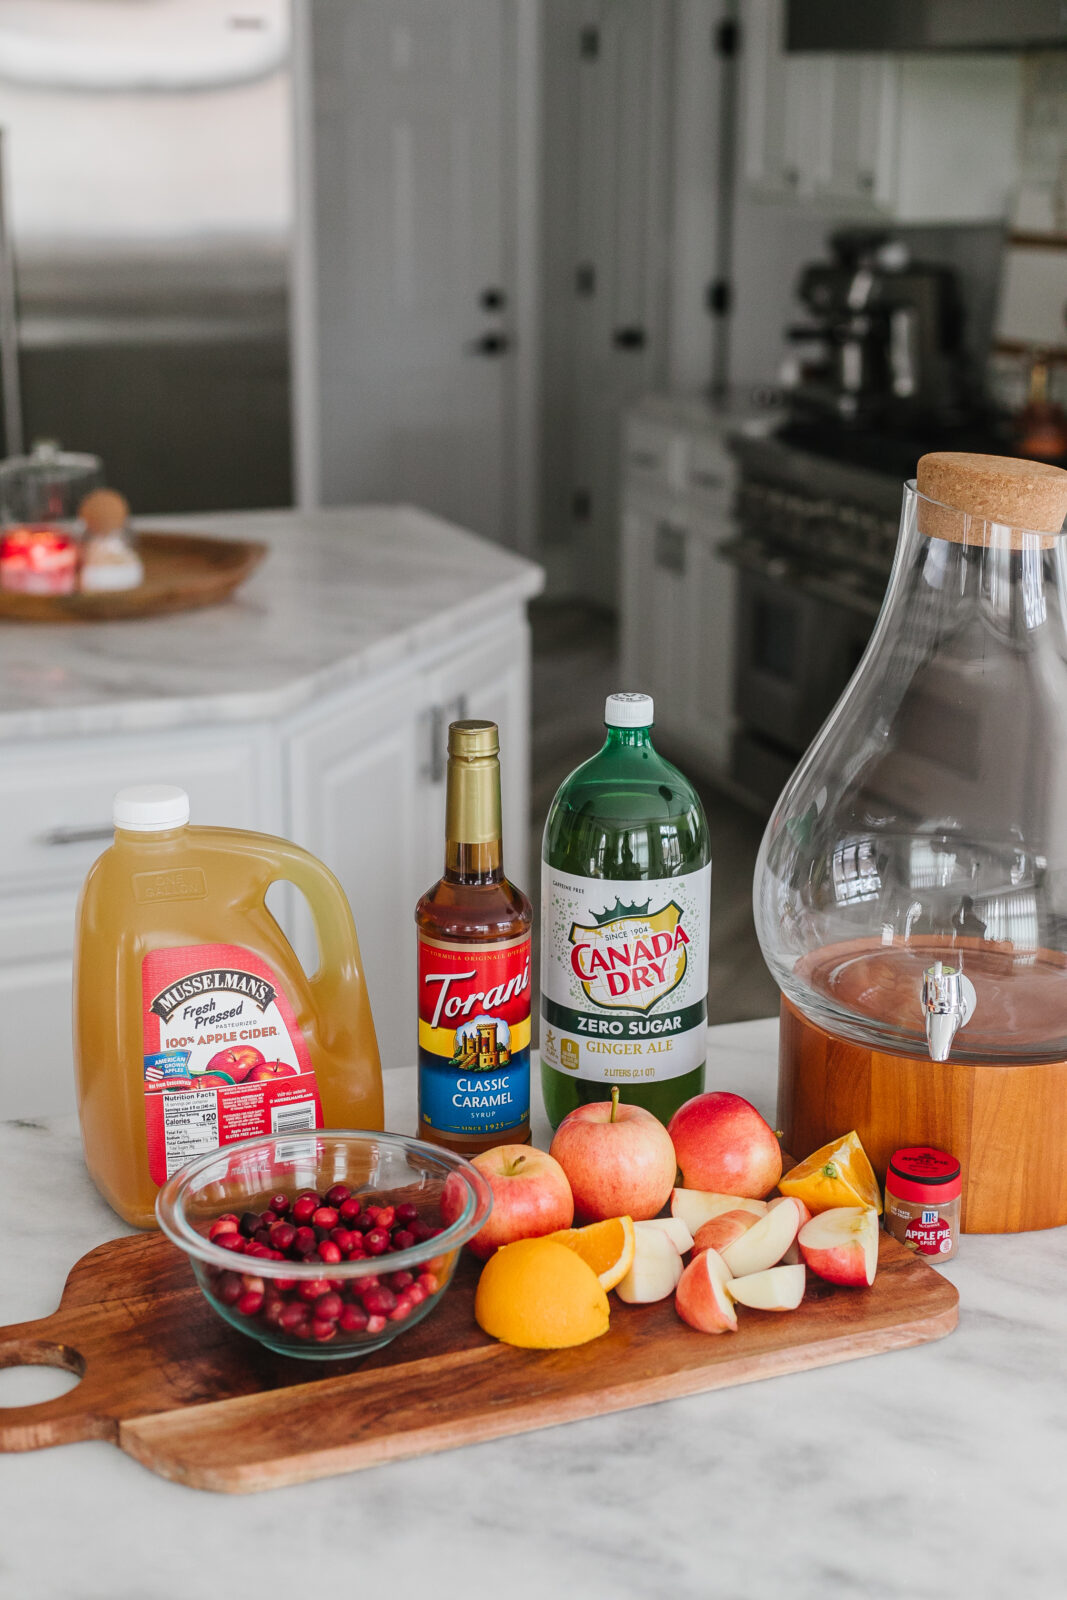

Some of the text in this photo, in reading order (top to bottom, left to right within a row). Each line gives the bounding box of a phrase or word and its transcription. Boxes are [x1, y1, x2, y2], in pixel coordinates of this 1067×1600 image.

[605, 926, 648, 941] SINCE 1904
[430, 951, 461, 960] FORMULA
[571, 924, 690, 981] CANADA
[606, 957, 667, 996] DRY
[158, 973, 269, 1012] MUSSELMAN'S
[425, 955, 529, 1028] Torani
[183, 998, 216, 1020] Fresh
[194, 1001, 244, 1029] Pressed
[215, 1020, 258, 1029] PASTEURIZED
[577, 1016, 682, 1035] ZERO SUGAR
[166, 1026, 277, 1049] 100% APPLE CIDER
[586, 1040, 673, 1055] GINGER ALE
[155, 1057, 186, 1065] AMERICAN
[604, 1068, 609, 1076] 2
[609, 1068, 631, 1077] LITERS
[632, 1069, 643, 1078] (2.1
[456, 1076, 510, 1092] CLASSIC
[164, 1094, 195, 1102] Nutrition
[452, 1092, 513, 1108] CARAMEL
[166, 1118, 190, 1126] Calories
[202, 1112, 216, 1121] 120
[905, 1229, 951, 1240] APPLE PIE
